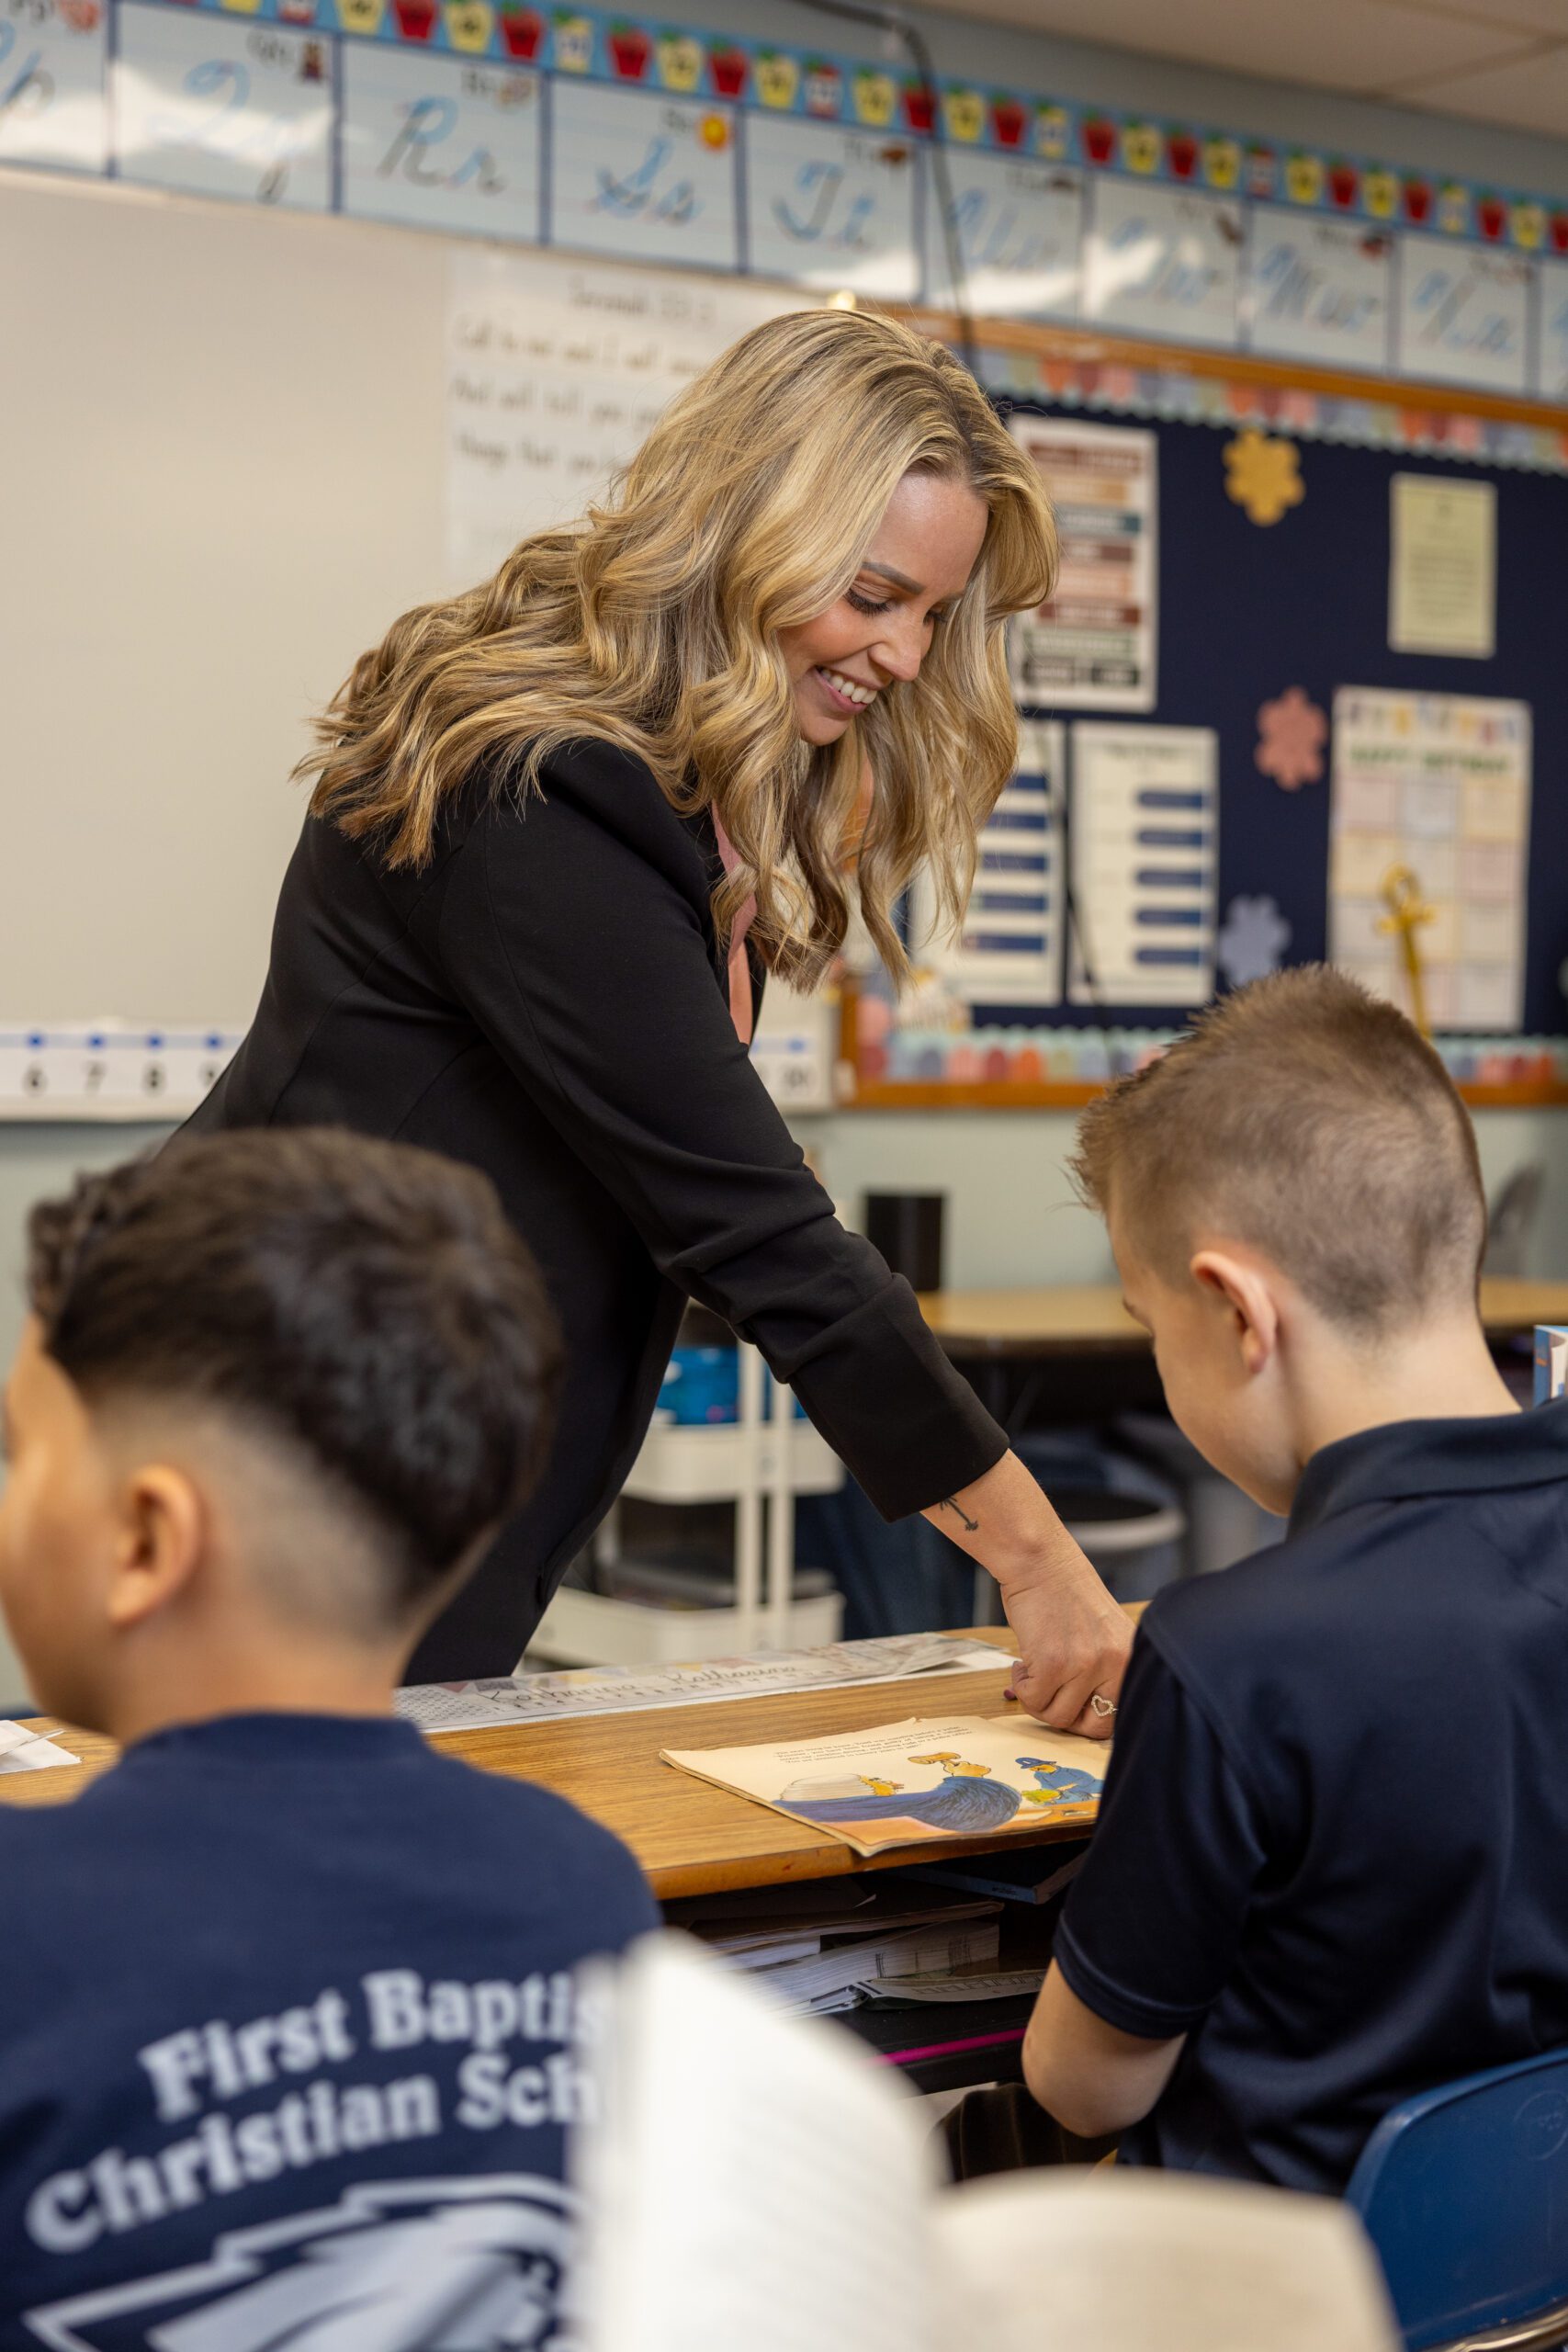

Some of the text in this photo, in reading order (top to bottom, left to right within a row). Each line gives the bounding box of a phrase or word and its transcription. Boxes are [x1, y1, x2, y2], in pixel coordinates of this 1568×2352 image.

[23, 1060, 46, 1098] 6
[84, 1060, 107, 1098] 7
[142, 1060, 166, 1098] 8
[137, 1987, 355, 2122] First
[23, 2074, 443, 2255] Christian
